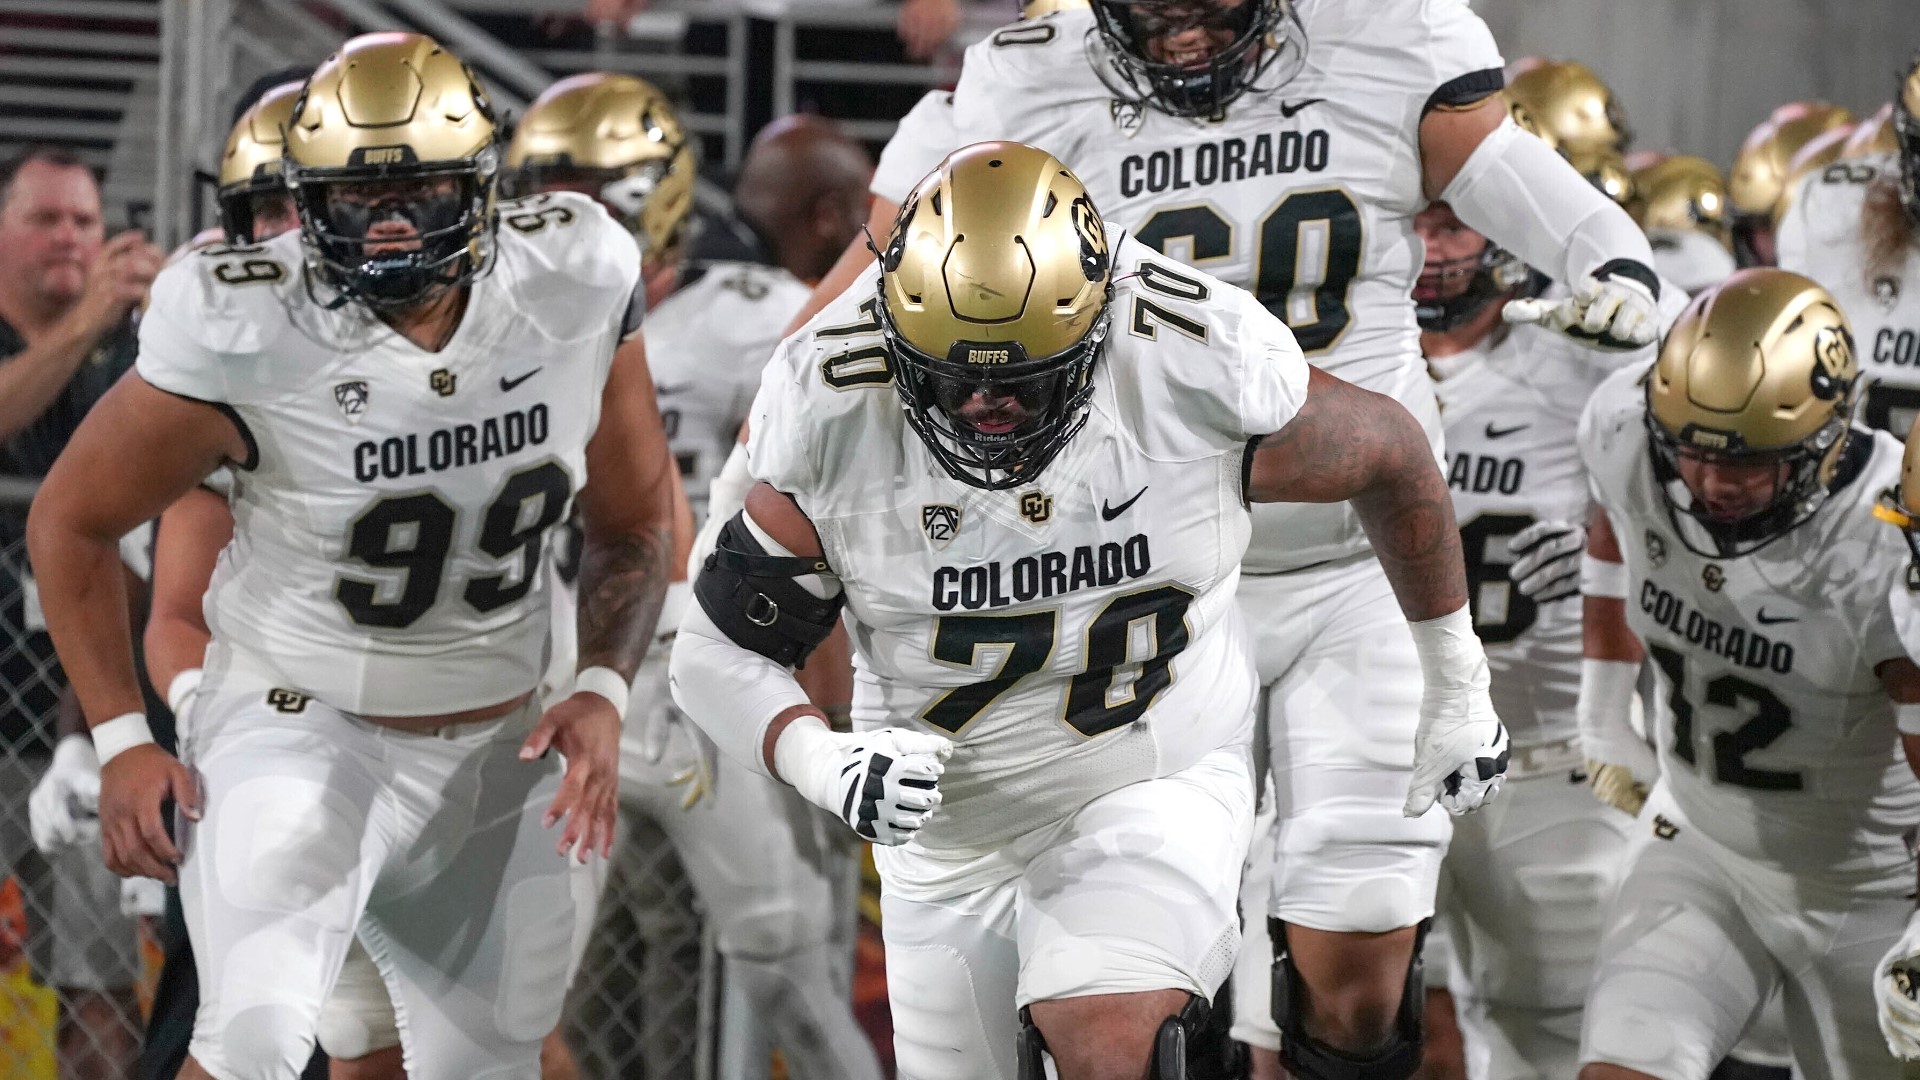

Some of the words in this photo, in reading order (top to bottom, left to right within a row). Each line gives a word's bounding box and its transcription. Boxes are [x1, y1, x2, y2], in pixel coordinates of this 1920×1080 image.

[1121, 129, 1330, 198] COLORADO
[814, 293, 896, 391] 70
[1130, 260, 1211, 345] 70
[430, 369, 457, 397] CU
[968, 350, 1009, 364] BUFFS
[354, 403, 548, 483] COLORADO
[334, 459, 573, 629] 99
[922, 505, 960, 533] PAC
[931, 524, 950, 540] 12
[1021, 492, 1052, 522] CU
[932, 533, 1151, 611] COLORADO
[917, 582, 1199, 739] 70
[1641, 579, 1794, 674] COLORADO
[1650, 643, 1804, 791] 12
